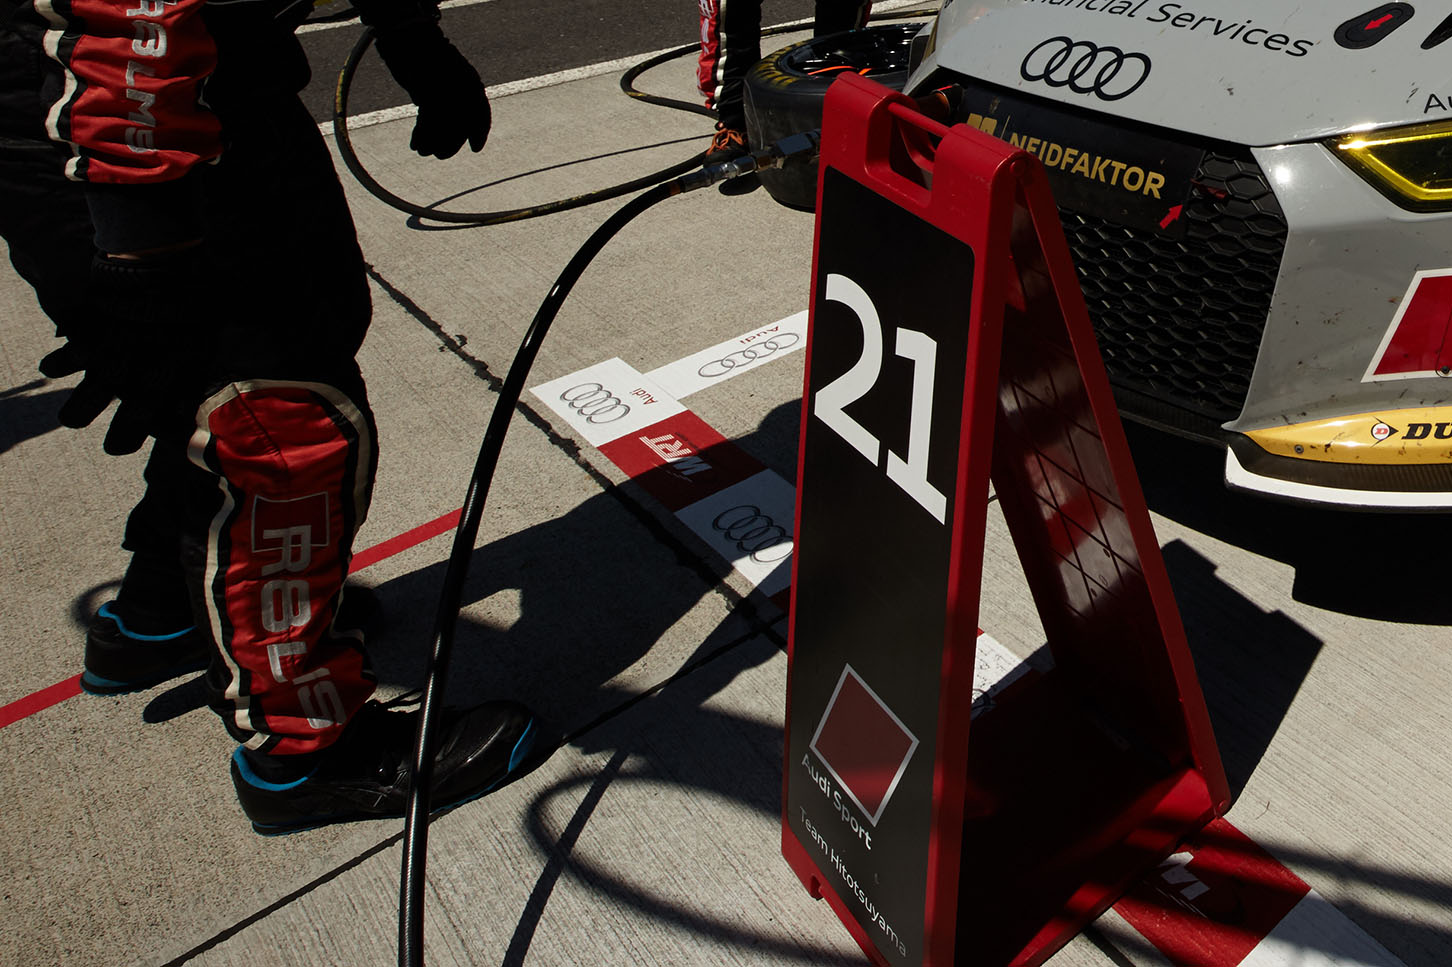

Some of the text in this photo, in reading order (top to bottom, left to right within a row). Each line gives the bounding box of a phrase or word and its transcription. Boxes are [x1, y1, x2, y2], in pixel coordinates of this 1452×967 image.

[1146, 3, 1314, 57] Services
[1009, 131, 1168, 199] NEIDFAKTOR
[739, 324, 780, 345] Audi
[628, 386, 659, 406] Audi
[813, 271, 948, 527] 21
[801, 752, 874, 851] Audi Sport
[799, 806, 909, 958] Team Hitotsuyama
